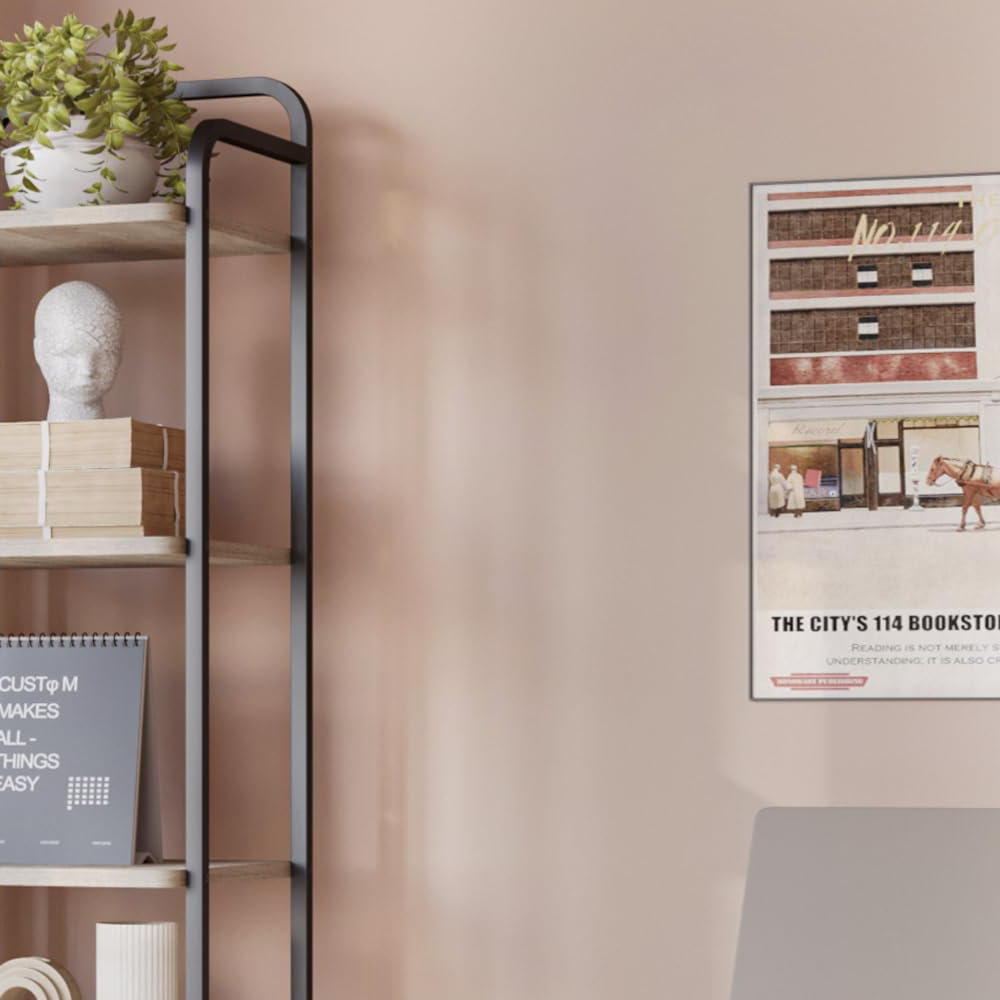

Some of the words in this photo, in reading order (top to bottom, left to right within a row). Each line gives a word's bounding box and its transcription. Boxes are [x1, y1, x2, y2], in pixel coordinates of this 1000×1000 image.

[772, 616, 805, 632] THE
[810, 615, 868, 632] CITY'S
[874, 615, 903, 631] 114
[909, 614, 1000, 631] BOOKSTO
[918, 644, 941, 652] NOT
[927, 657, 938, 665] IT
[953, 656, 985, 664] ALSO
